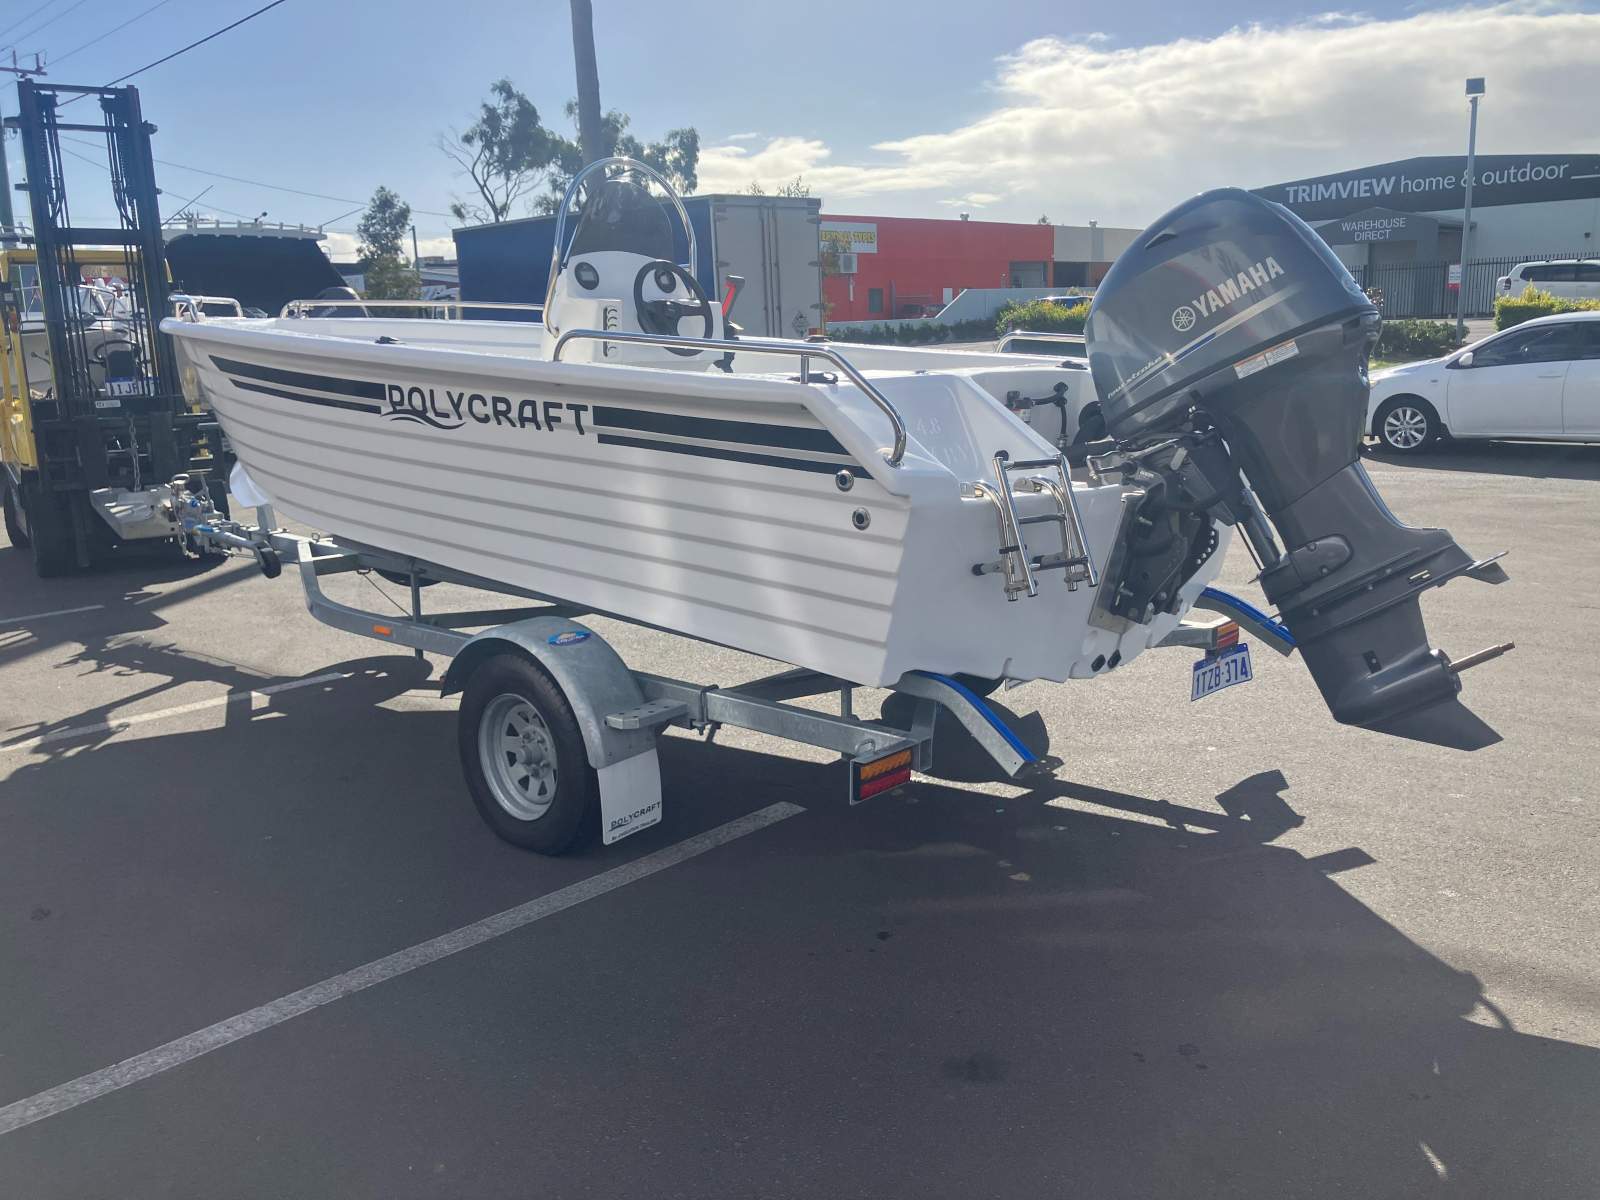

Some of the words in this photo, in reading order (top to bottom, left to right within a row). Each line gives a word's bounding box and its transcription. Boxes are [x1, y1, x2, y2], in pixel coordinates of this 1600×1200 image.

[1286, 176, 1396, 204] TRIMVIEW
[1400, 174, 1456, 193] home
[1481, 162, 1570, 186] outdoor
[1341, 217, 1407, 232] WAREHOUSE
[1354, 229, 1393, 242] DIRECT
[1192, 256, 1285, 318] YAMAHA
[386, 384, 589, 435] POLYCRAFT
[611, 804, 661, 829] POLYCRAFT
